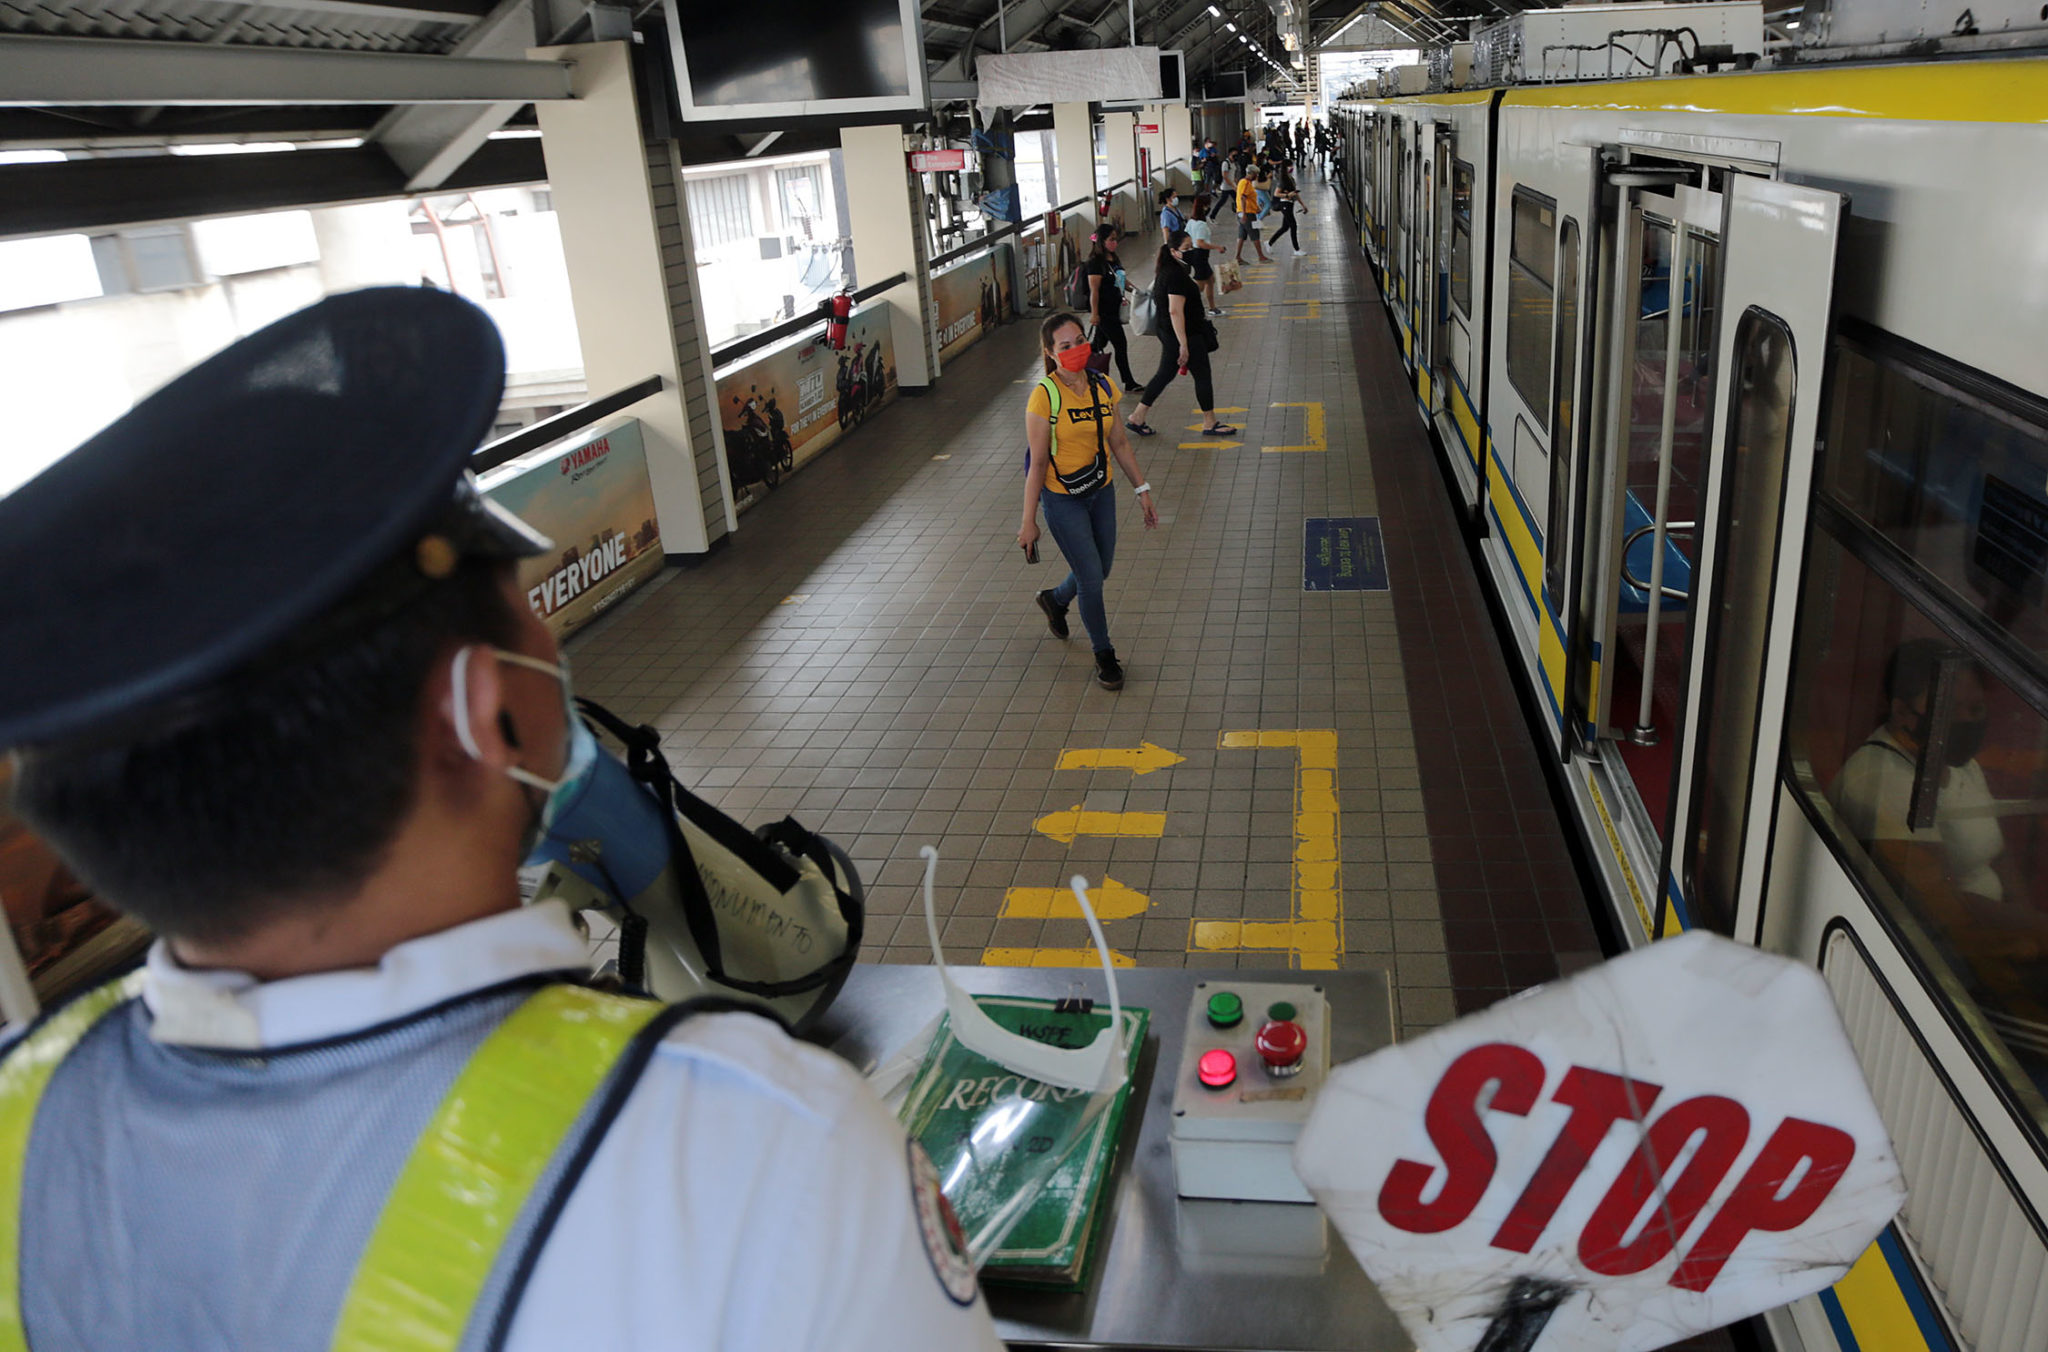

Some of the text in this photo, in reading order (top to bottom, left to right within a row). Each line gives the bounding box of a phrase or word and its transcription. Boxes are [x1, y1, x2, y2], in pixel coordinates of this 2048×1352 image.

[571, 438, 610, 469] YAMAHA
[528, 531, 628, 620] EVERYONE
[1378, 1042, 1857, 1293] STOP
